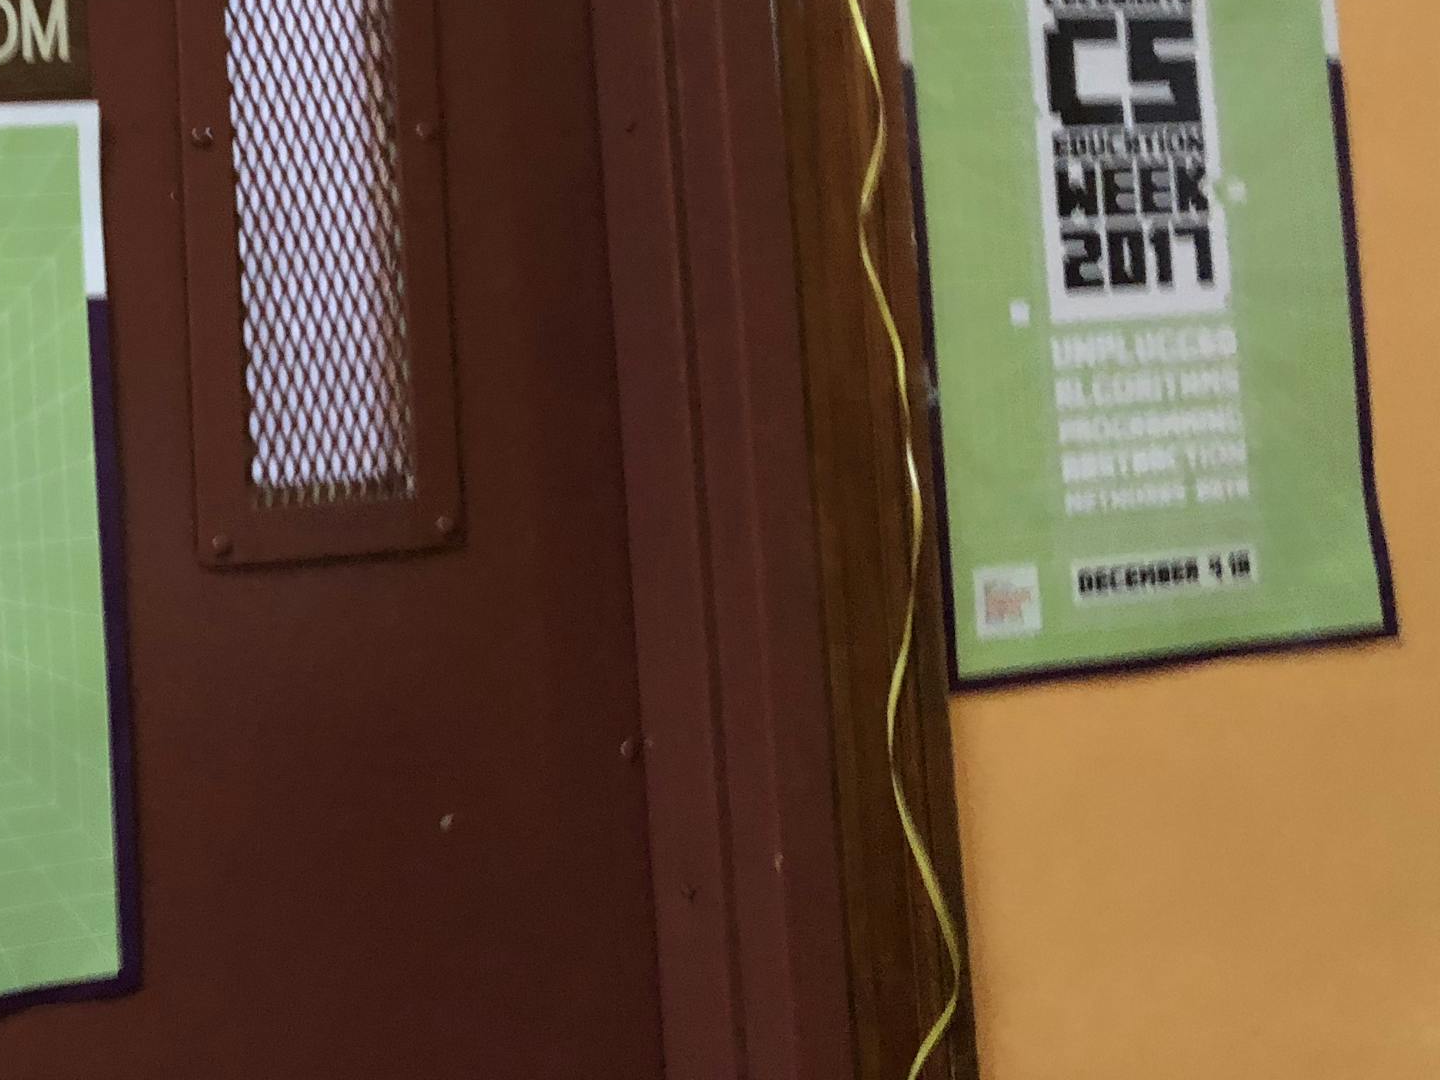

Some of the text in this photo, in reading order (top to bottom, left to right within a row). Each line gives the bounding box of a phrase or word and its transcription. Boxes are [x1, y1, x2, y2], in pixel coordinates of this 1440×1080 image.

[1042, 12, 1203, 126] CS
[1051, 126, 1206, 158] EDUCATION
[1054, 158, 1209, 219] WEEK
[1060, 223, 1215, 291] 2017
